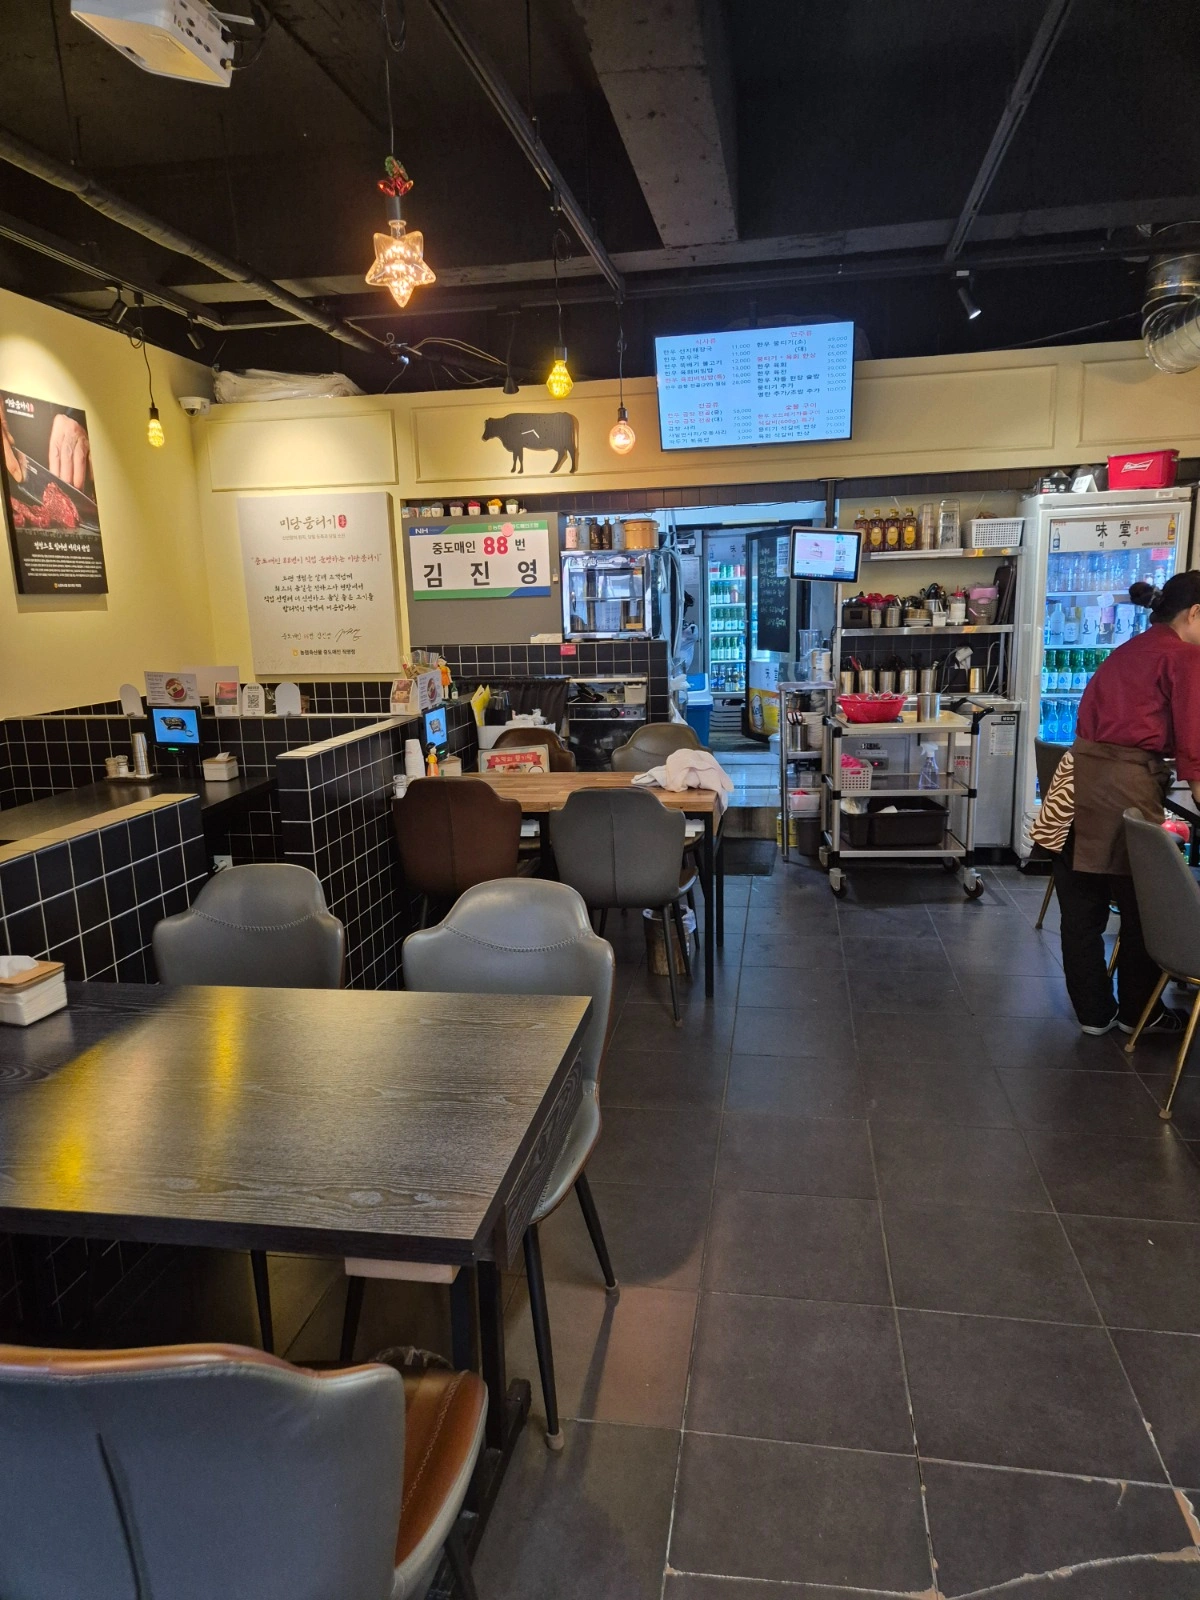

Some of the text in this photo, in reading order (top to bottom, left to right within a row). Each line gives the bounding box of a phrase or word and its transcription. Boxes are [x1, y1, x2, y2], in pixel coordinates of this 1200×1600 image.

[1096, 521, 1108, 539] 味
[1119, 520, 1131, 538] 堂
[432, 536, 526, 555] 중도매인 88 번
[423, 559, 538, 588] 김 진 영
